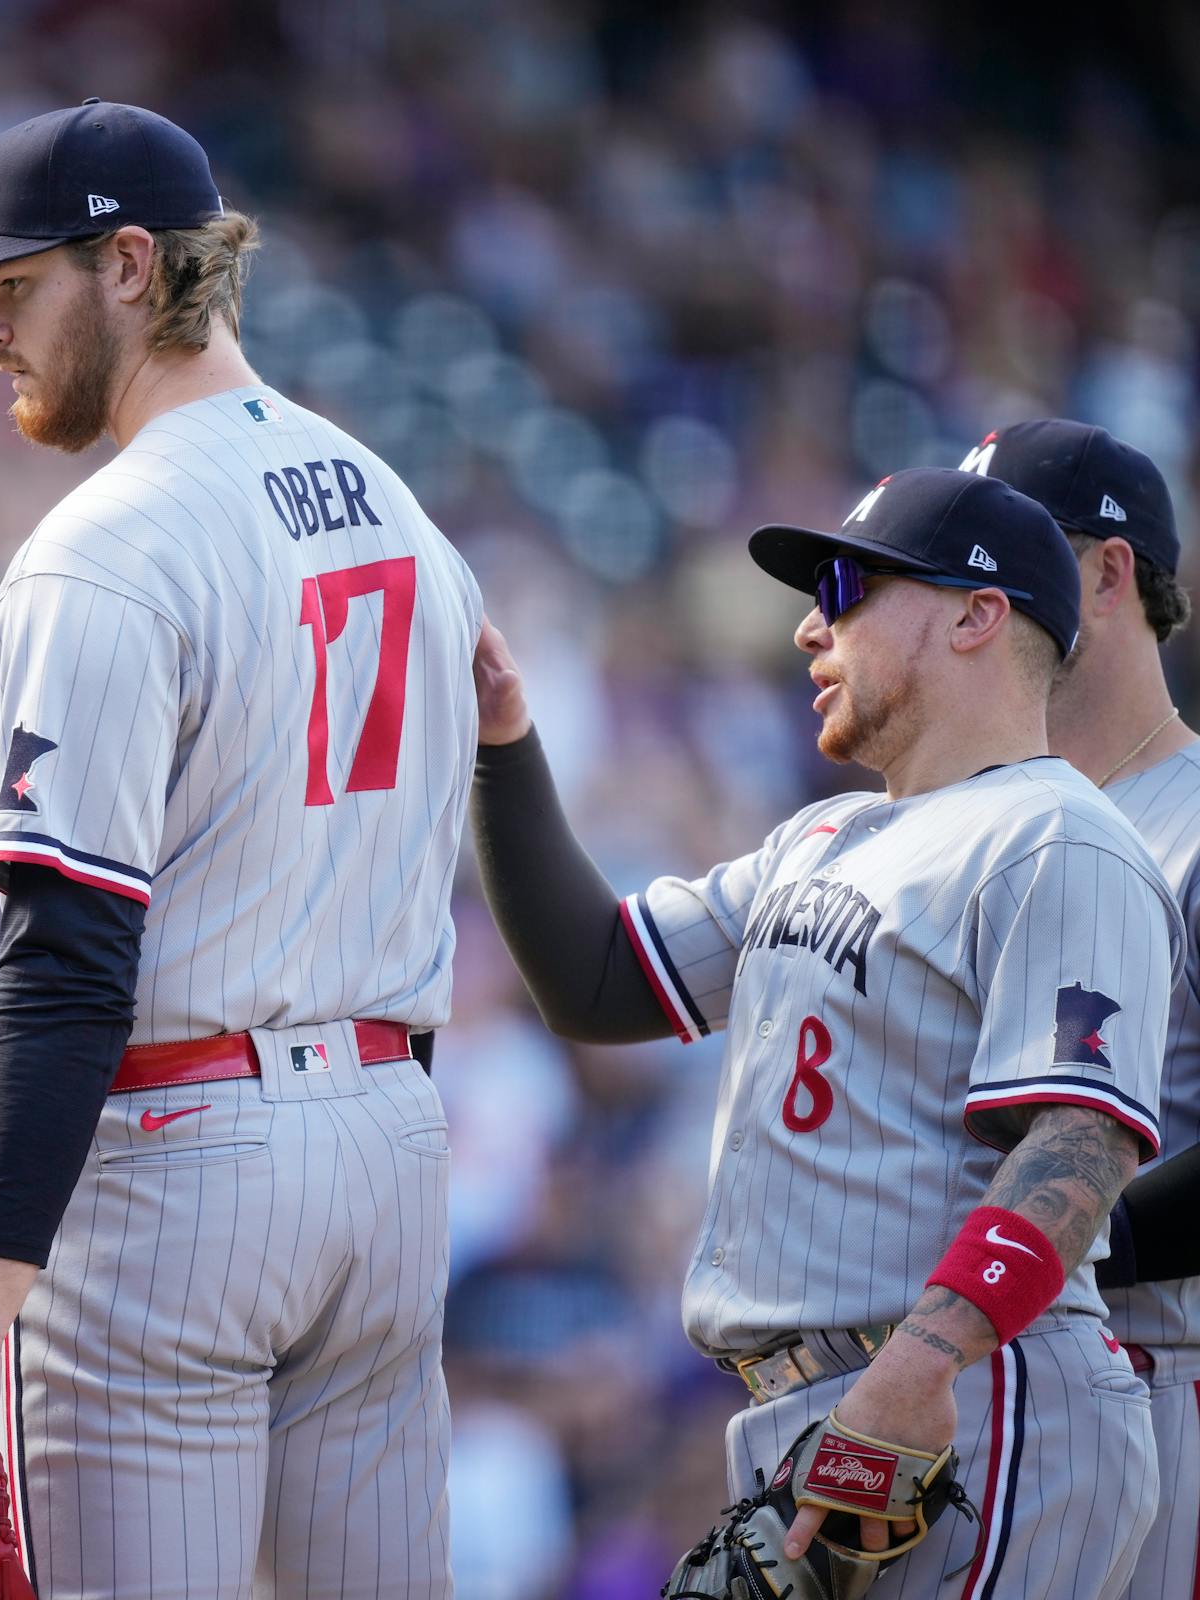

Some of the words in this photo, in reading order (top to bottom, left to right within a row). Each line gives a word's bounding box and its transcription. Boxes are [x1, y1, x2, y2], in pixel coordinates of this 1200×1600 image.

[263, 458, 383, 542] OBER
[299, 555, 416, 807] 17
[782, 1015, 834, 1132] 8
[982, 1260, 1006, 1285] 8
[817, 1457, 885, 1491] Rawlings
